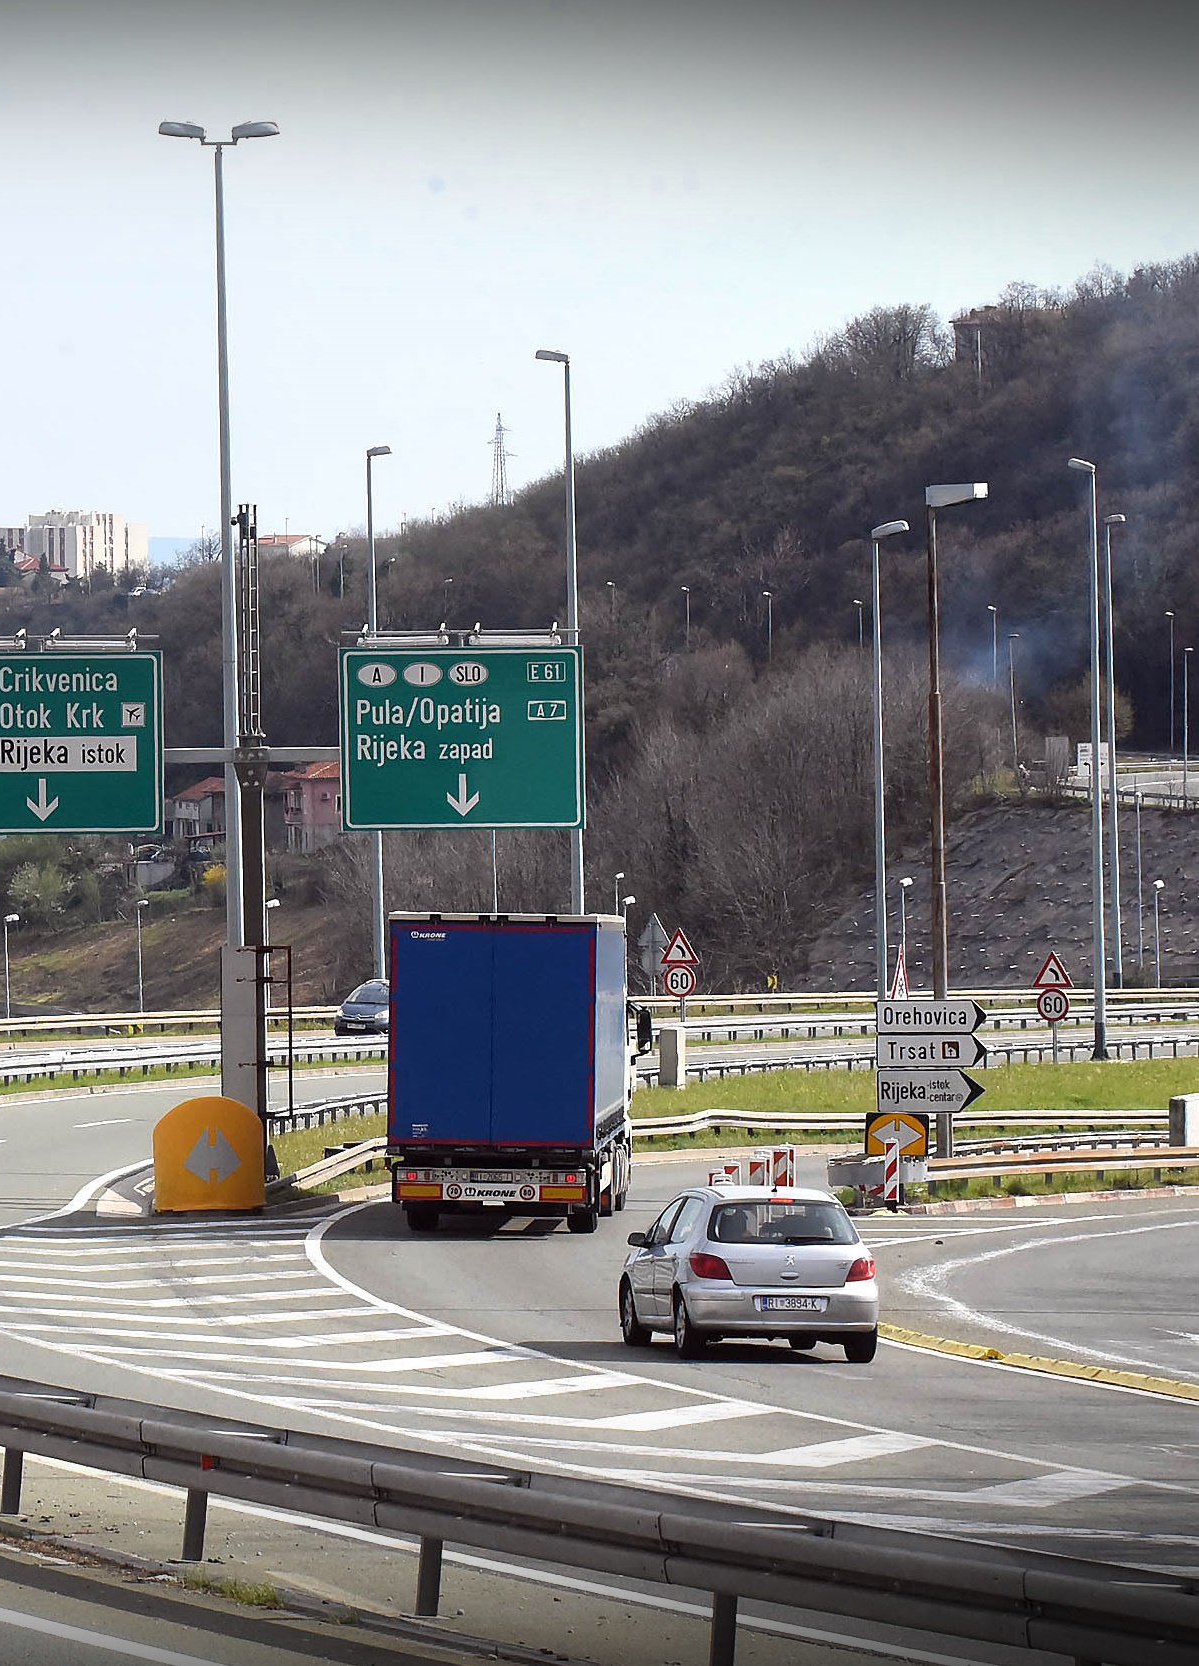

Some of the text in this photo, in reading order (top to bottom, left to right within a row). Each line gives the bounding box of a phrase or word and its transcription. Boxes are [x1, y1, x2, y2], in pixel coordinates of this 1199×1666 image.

[0, 666, 118, 692] Crikvenica
[372, 667, 382, 683] A
[456, 665, 481, 682] SLO
[531, 664, 560, 680] E 61
[0, 702, 104, 729] Otok Krk
[356, 696, 501, 730] Pula/Opatija
[537, 704, 558, 717] A 7
[0, 738, 126, 771] Rijeka istok
[357, 734, 493, 767] Rijeka zapad
[670, 972, 689, 989] 60
[1043, 996, 1063, 1013] 60
[883, 1007, 967, 1025] Orehovica
[887, 1041, 936, 1060] Trsat
[880, 1081, 927, 1104] Rijeka
[476, 1188, 517, 1198] KRONE
[768, 1298, 778, 1308] RI
